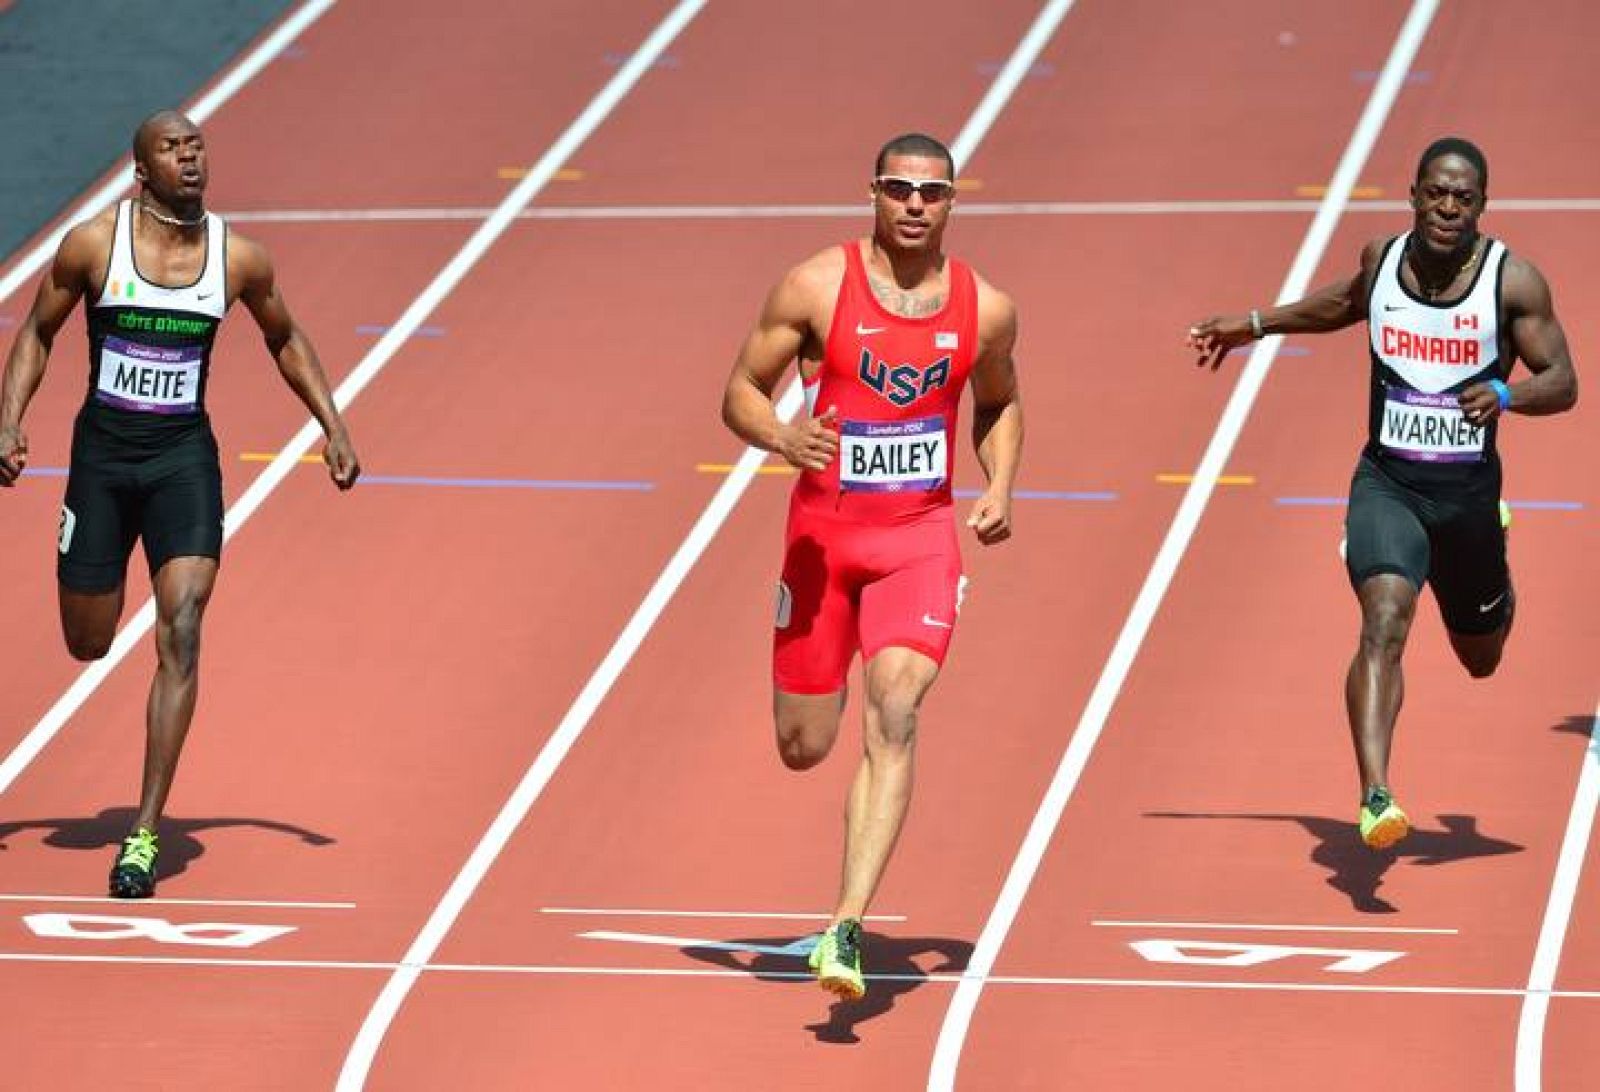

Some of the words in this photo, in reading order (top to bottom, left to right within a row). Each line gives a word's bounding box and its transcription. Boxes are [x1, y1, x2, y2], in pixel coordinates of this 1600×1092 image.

[1382, 326, 1479, 366] CANADA
[113, 362, 188, 399] MEITE
[858, 346, 953, 408] USA
[867, 426, 903, 436] London
[904, 422, 924, 433] 2012
[1387, 408, 1481, 446] WARNER
[851, 440, 939, 476] BAILEY
[22, 912, 299, 948] 8
